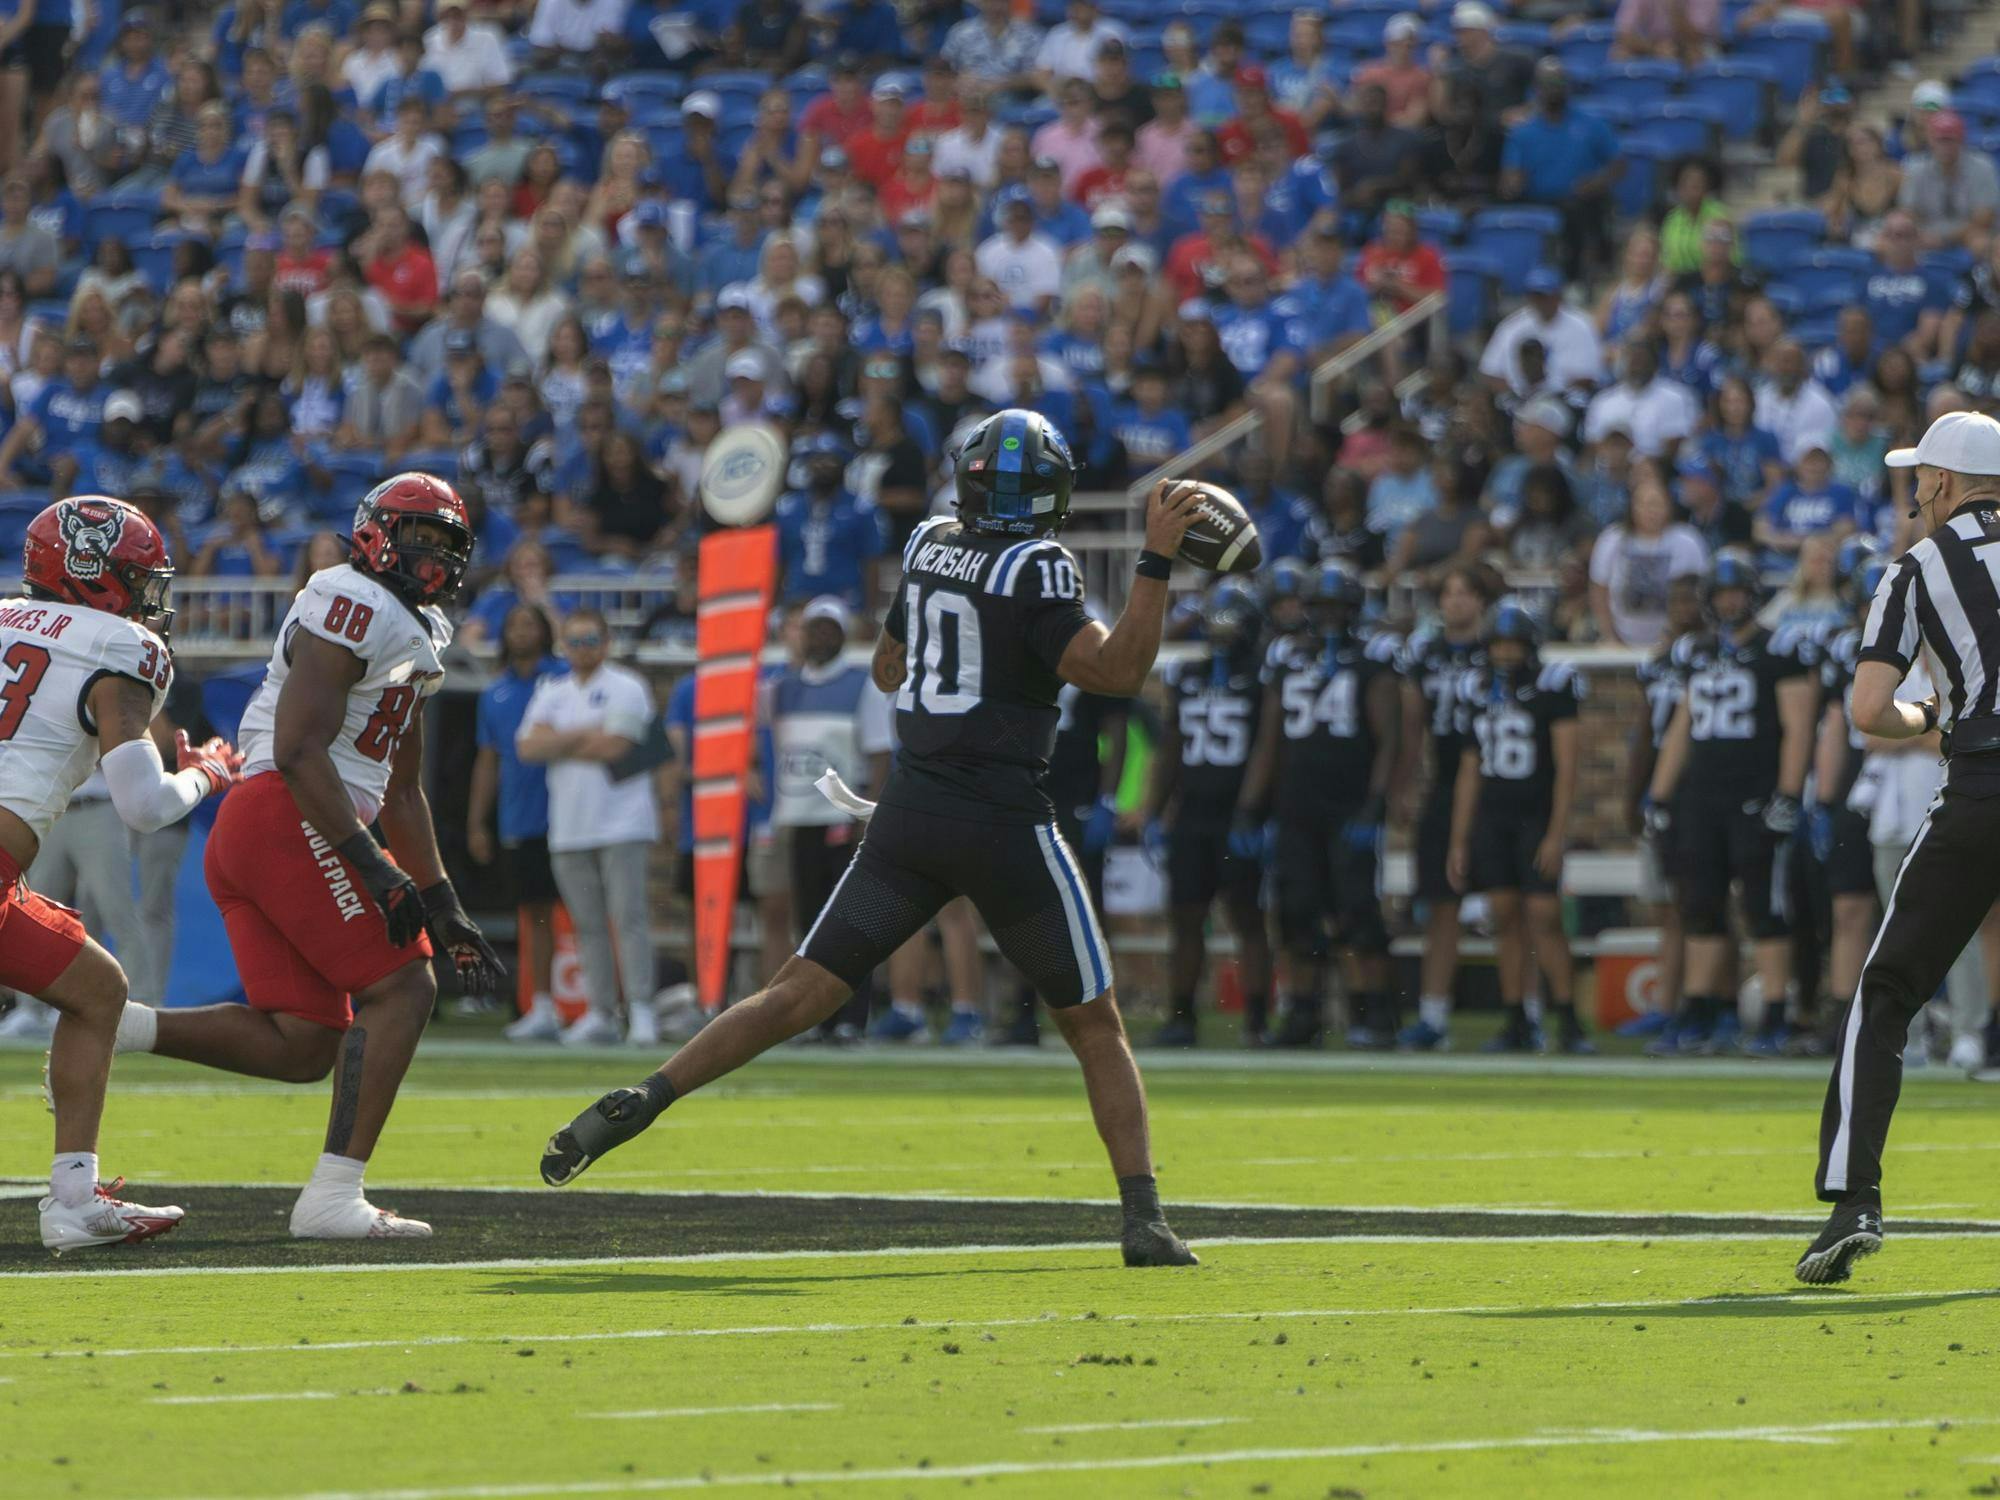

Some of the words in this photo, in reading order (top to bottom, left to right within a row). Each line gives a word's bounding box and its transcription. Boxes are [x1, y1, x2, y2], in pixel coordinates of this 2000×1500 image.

[91, 509, 108, 520] STATE
[911, 541, 988, 583] MENSAH
[1036, 559, 1075, 599] 10
[40, 614, 73, 640] JR
[324, 595, 374, 643] 88
[138, 639, 171, 690] 33
[896, 583, 983, 715] 10
[0, 640, 52, 741] 3
[1281, 669, 1359, 739] 54
[1179, 697, 1251, 767] 55
